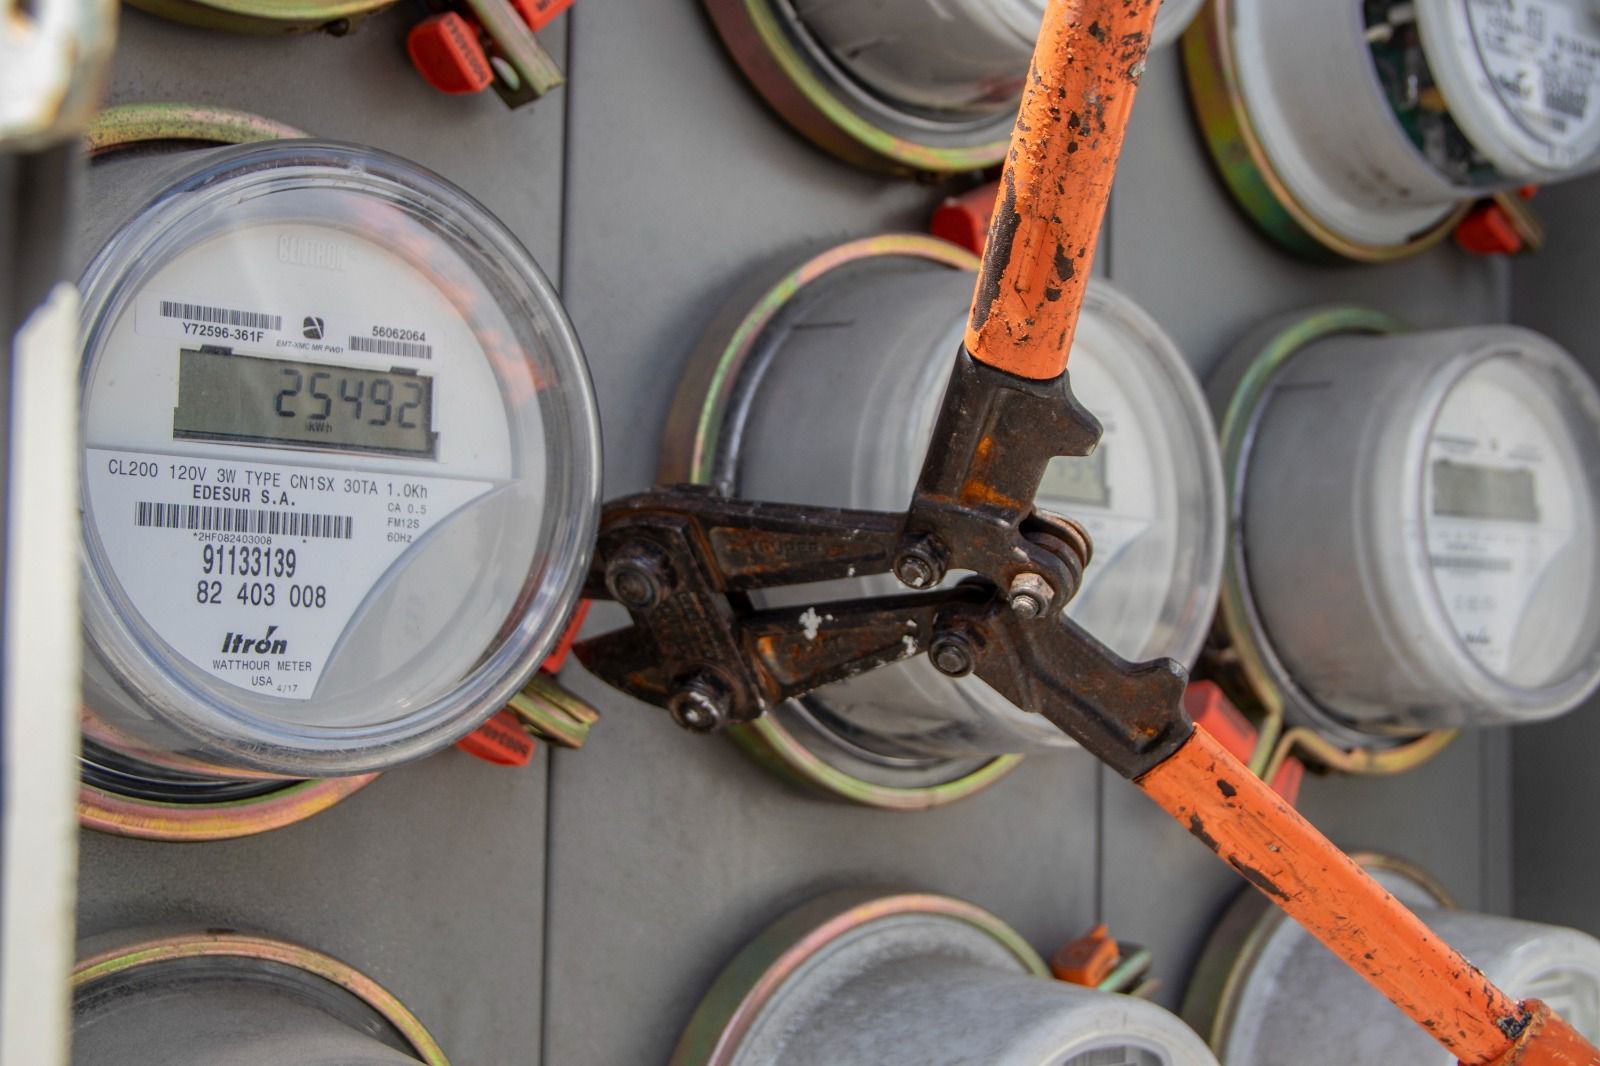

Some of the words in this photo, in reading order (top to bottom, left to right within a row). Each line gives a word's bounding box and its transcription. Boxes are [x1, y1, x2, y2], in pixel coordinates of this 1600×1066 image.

[182, 322, 265, 343] Y72596-361F
[371, 325, 426, 342] 56062064
[275, 368, 423, 429] 25492
[108, 458, 159, 478] CL200
[169, 464, 207, 481] 120V
[216, 468, 237, 484] 3W
[245, 470, 281, 488] TYPE
[290, 473, 335, 492] CN1SX
[344, 478, 378, 495] 30TA
[387, 482, 428, 499] 1.0Kh
[193, 484, 251, 503] EDESUR
[261, 489, 296, 506] S.A.
[387, 502, 401, 513] CA
[407, 504, 427, 515] 0.5
[387, 517, 420, 529] FM12S
[387, 532, 412, 543] 60Hz
[203, 543, 297, 578] 91133139
[196, 580, 223, 604] 82
[236, 582, 275, 606] 403
[289, 584, 326, 608] 008
[212, 659, 270, 671] WATTHOUR
[277, 661, 312, 672] METER
[251, 676, 273, 686] USA
[277, 684, 298, 693] 4/17
